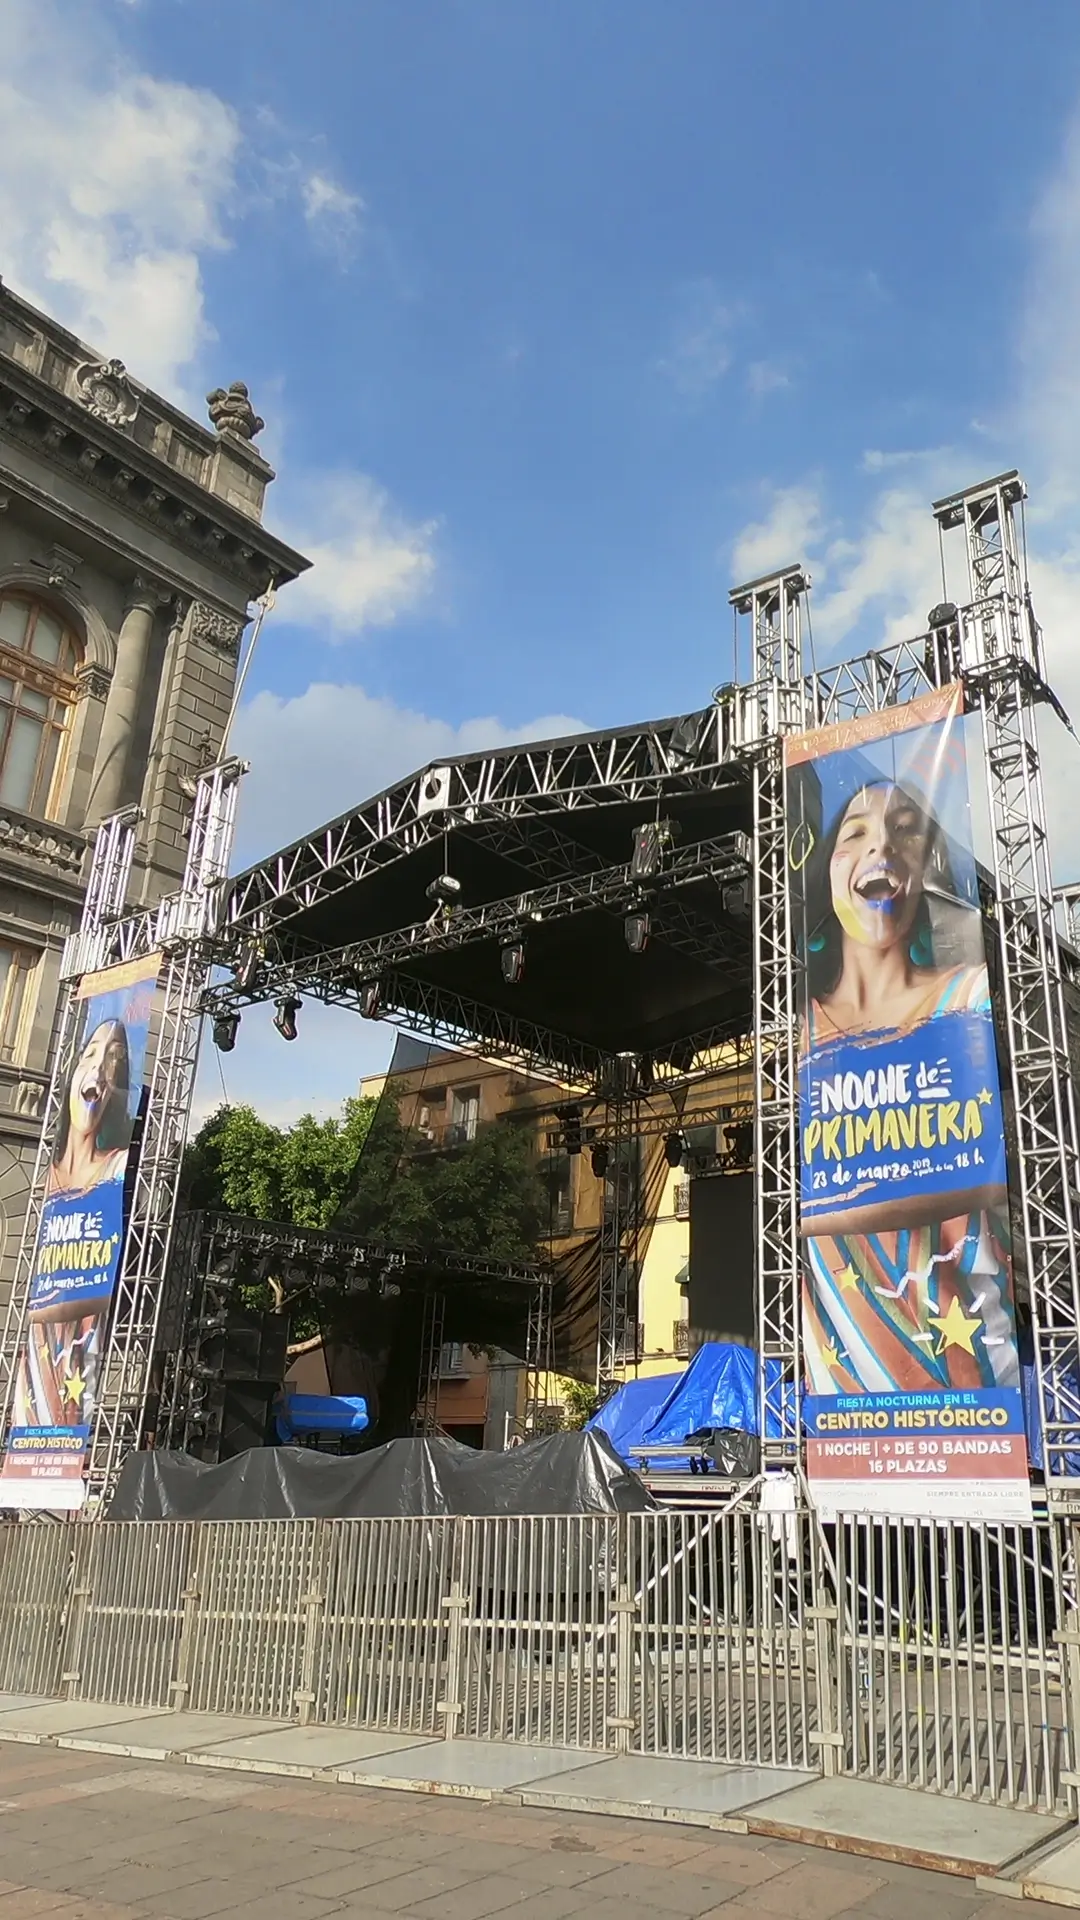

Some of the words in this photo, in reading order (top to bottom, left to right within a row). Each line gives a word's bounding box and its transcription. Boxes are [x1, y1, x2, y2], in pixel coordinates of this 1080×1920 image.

[820, 1064, 911, 1114] NOCHE
[915, 1061, 940, 1089] de
[803, 1100, 982, 1164] PRIMAVERA
[954, 1152, 970, 1168] 18
[973, 1147, 985, 1165] h
[812, 1170, 828, 1189] 23
[832, 1162, 852, 1185] de
[856, 1162, 911, 1180] marzo
[836, 1397, 873, 1408] FIESTA
[876, 1394, 942, 1407] NOCTURNA
[943, 1394, 960, 1405] EN
[963, 1393, 978, 1404] EL
[816, 1411, 889, 1430] CENTRO
[893, 1405, 1008, 1428] HISTÓRICO
[12, 1437, 46, 1449] CENTRO
[816, 1443, 822, 1456] 1
[825, 1442, 871, 1456] NOCHE
[894, 1442, 916, 1455] DE
[919, 1442, 938, 1455] 90
[943, 1440, 1012, 1455] BANDAS
[869, 1460, 883, 1473] 16
[886, 1459, 947, 1473] PLAZAS
